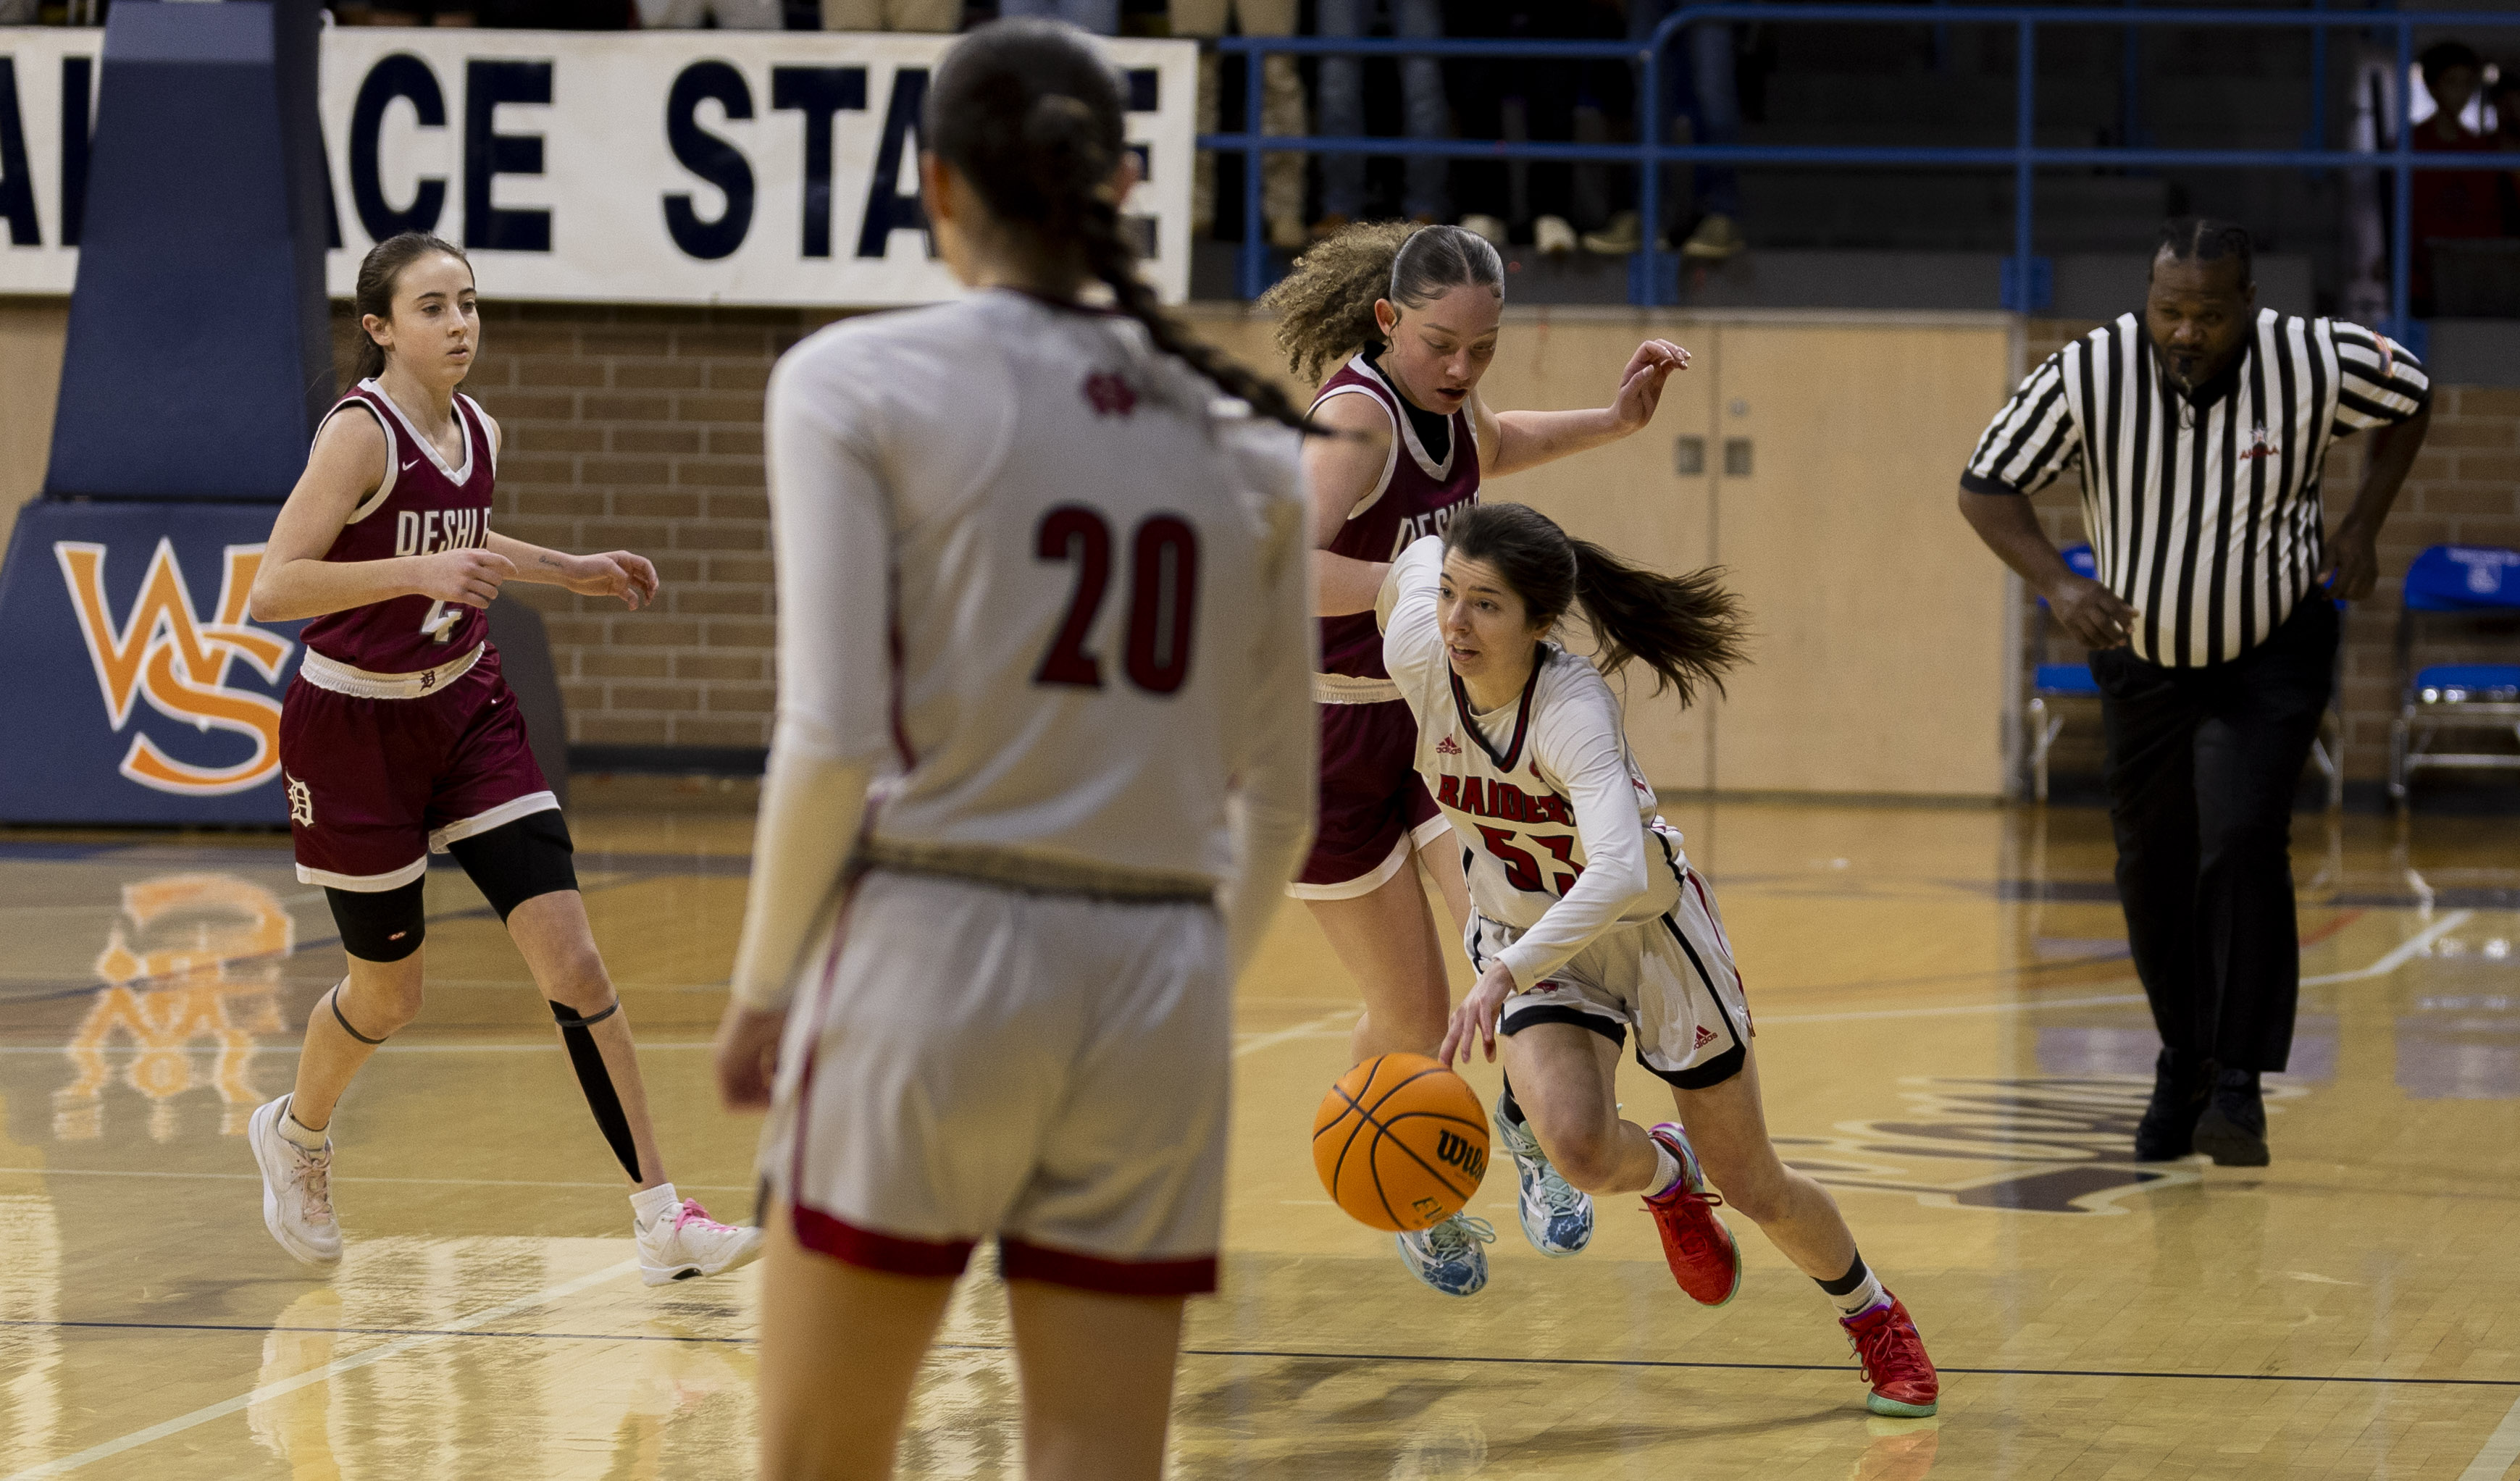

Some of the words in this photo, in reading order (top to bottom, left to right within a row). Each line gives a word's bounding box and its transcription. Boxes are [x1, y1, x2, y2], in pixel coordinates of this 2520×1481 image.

[662, 59, 1158, 260] STA
[419, 600, 463, 644] 4
[1034, 502, 1197, 696] 20
[1472, 822, 1586, 899] 53
[1694, 1032, 1718, 1051] didas
